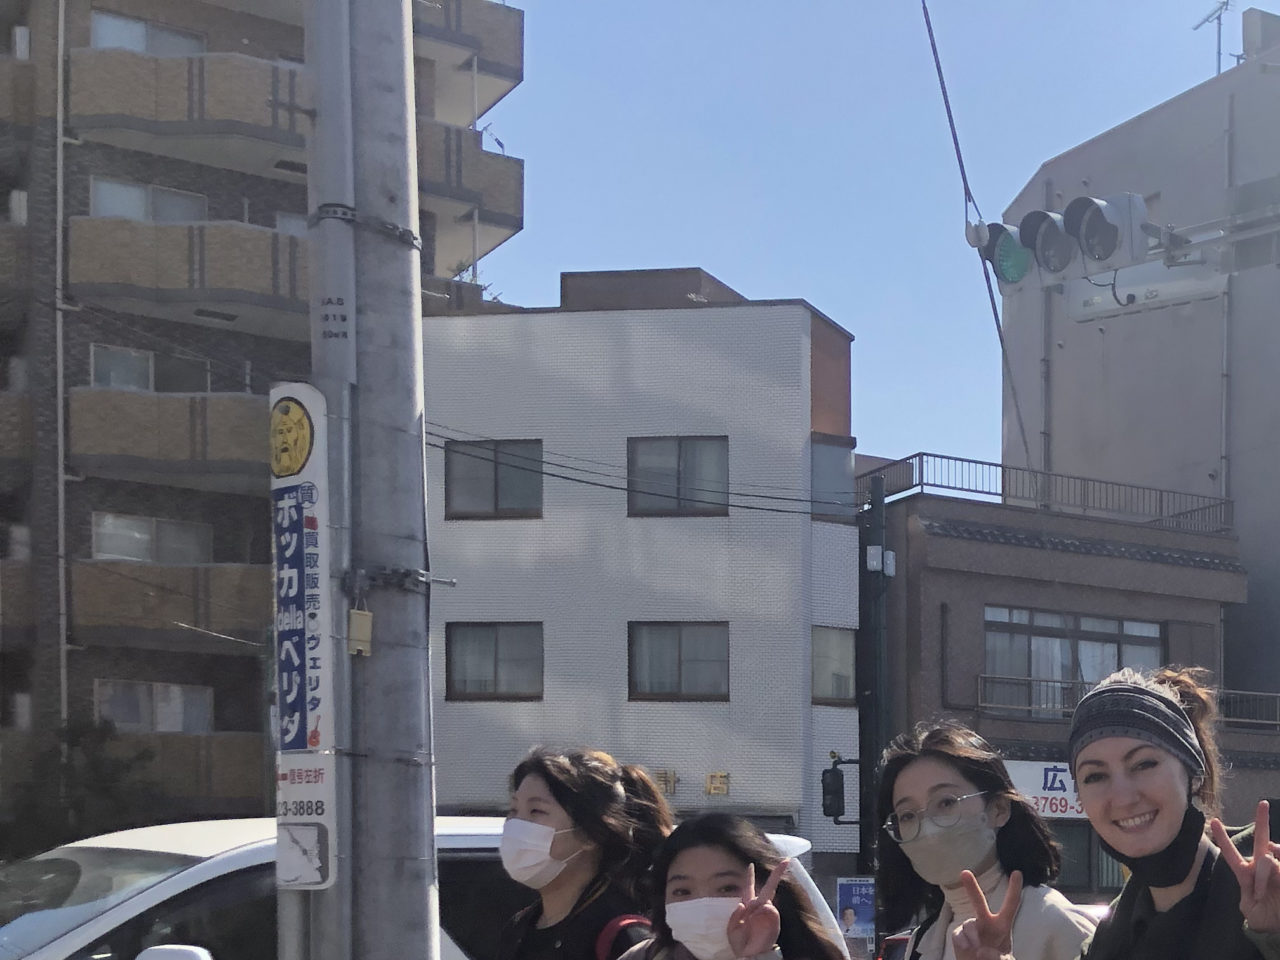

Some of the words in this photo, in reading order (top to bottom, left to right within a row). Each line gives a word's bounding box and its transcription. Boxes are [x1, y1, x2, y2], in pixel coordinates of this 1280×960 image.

[304, 531, 320, 611] 買取販売
[1042, 765, 1078, 793] 広
